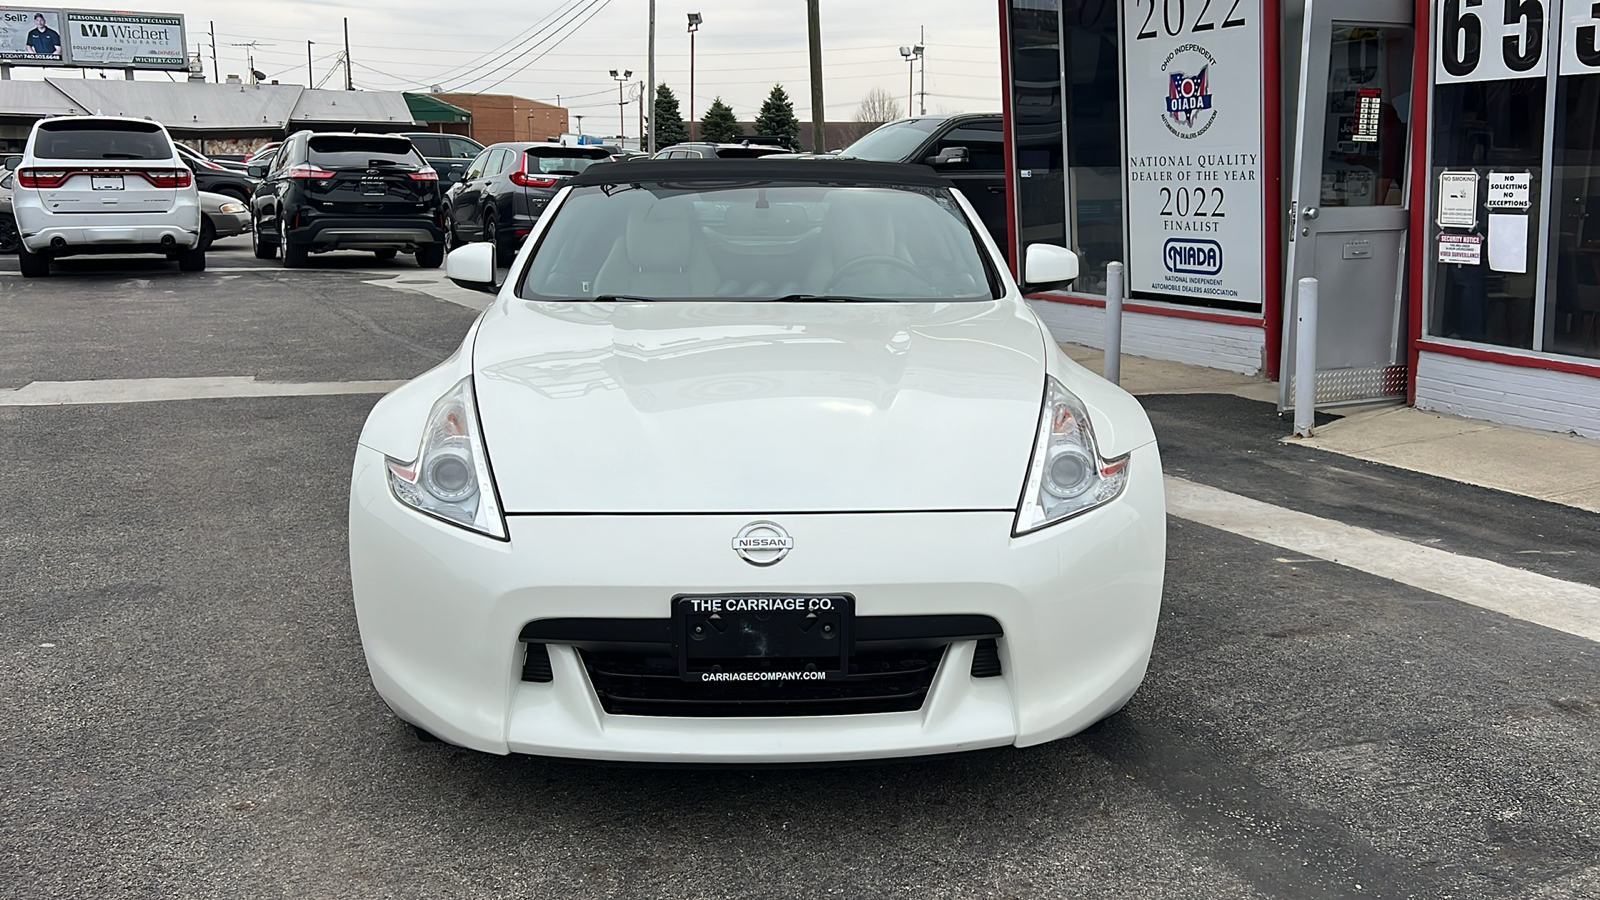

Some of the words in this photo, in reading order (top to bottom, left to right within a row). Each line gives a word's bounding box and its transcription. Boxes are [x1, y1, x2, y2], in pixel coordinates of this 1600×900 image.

[4, 13, 28, 22] Sell?
[140, 17, 179, 25] SPECIALISTS
[110, 25, 169, 40] Wichert
[1160, 52, 1175, 72] OHIO
[1173, 43, 1217, 66] INDEPENDENT
[1171, 97, 1204, 111] OIADA
[1160, 114, 1181, 138] AUTOMOBILE
[1180, 132, 1197, 140] DEALERS
[1197, 109, 1218, 137] ASSOCIATION
[1130, 155, 1192, 167] NATIONAL
[1198, 154, 1257, 168] QUALITY
[1131, 171, 1173, 181] DEALER
[1177, 171, 1192, 181] OF
[1196, 170, 1219, 181] THE
[1224, 170, 1256, 181] YEAR
[1159, 186, 1226, 218] 2022
[1164, 220, 1220, 232] FINALIST
[1441, 235, 1463, 243] SECURITY
[1463, 236, 1480, 244] NOTICE
[1168, 245, 1217, 268] NIADA
[1452, 251, 1480, 259] SURVEILLANCE
[1164, 275, 1188, 284] NATIONAL
[1189, 277, 1223, 286] INDEPENDENT
[1151, 283, 1181, 292] AUTOMOBILE
[1182, 285, 1203, 294] DEALERS
[1203, 287, 1238, 297] ASSOCIATION
[739, 539, 787, 547] NISSAN
[691, 599, 722, 612] THE
[726, 599, 805, 611] CARRIAGE
[808, 598, 835, 611] CO.
[701, 671, 826, 682] CARRIAGECOMPANY.COM
